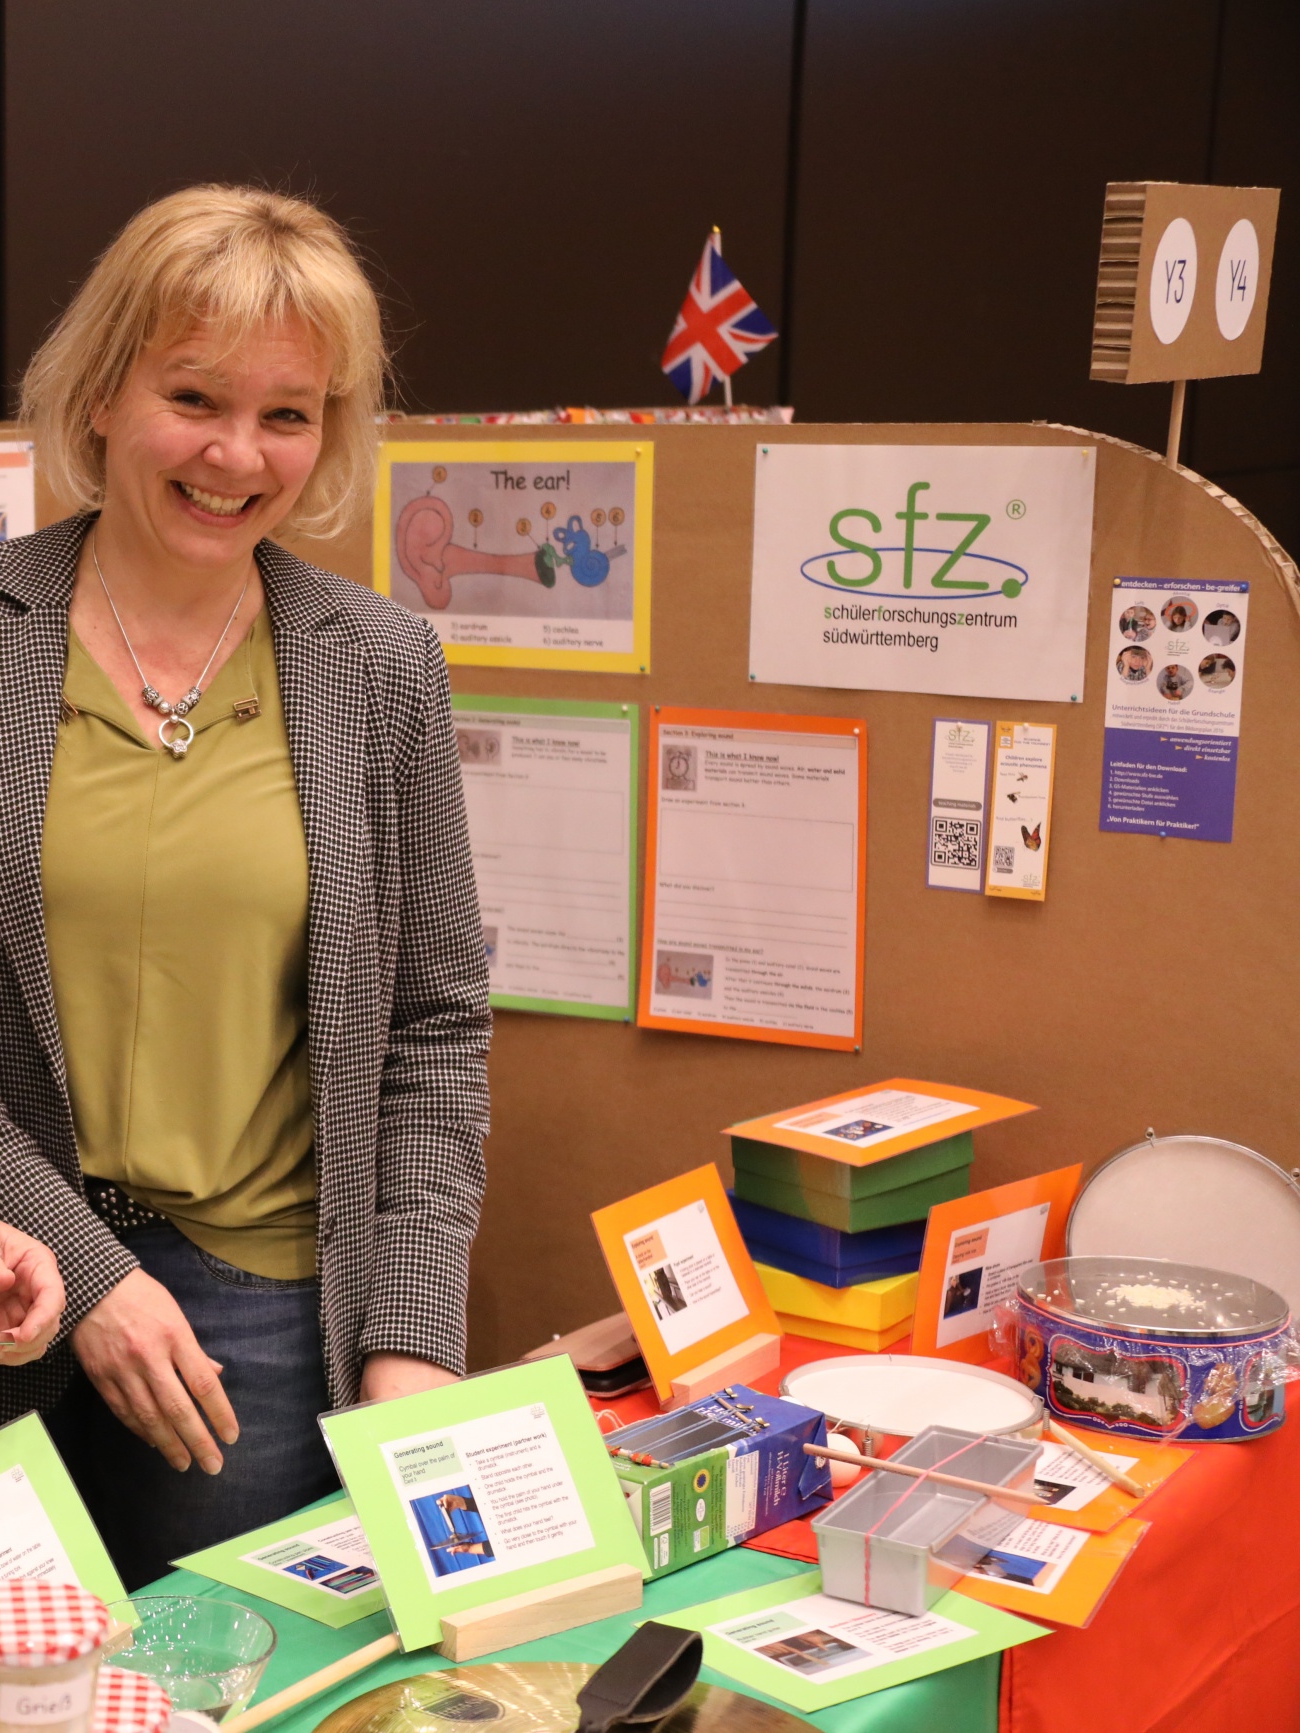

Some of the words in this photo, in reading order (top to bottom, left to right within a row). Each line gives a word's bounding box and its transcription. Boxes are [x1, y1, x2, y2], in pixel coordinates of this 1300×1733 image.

[1165, 260, 1186, 304] Y3
[1230, 260, 1246, 302] Y4
[490, 470, 526, 490] The
[533, 470, 570, 490] ear!
[827, 482, 991, 589] sfz
[824, 604, 1018, 628] schülerforschungszentrum
[822, 630, 939, 652] südwürttemberg
[1112, 704, 1166, 713] Unterrichtsideen
[1191, 709, 1234, 718] Grundschule
[393, 1446, 425, 1458] Generating
[425, 1440, 443, 1450] sound
[465, 1448, 485, 1457] Student
[485, 1441, 512, 1452] experiment
[513, 1436, 531, 1446] (partner
[398, 1463, 417, 1472] Cymbal
[437, 1454, 449, 1462] palm
[401, 1472, 412, 1480] your
